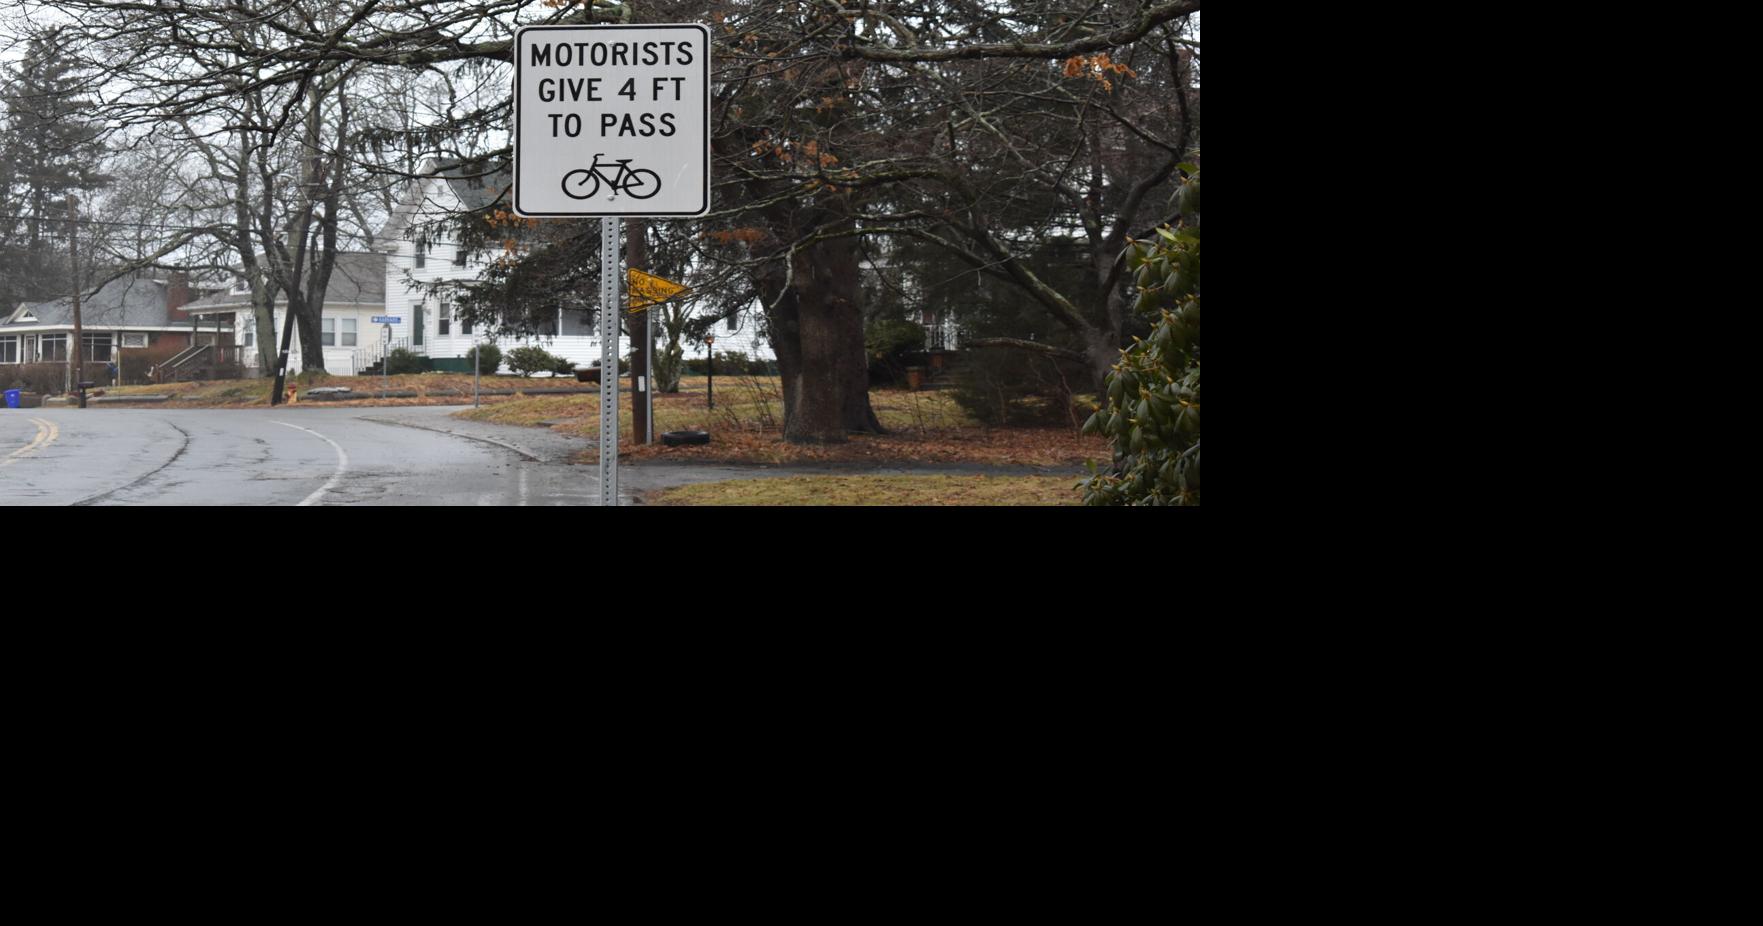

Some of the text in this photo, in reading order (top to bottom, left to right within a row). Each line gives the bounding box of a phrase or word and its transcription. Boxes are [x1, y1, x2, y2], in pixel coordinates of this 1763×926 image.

[531, 42, 693, 67] MOTORISTS
[538, 77, 686, 102] GIVE 4 FT
[548, 112, 676, 138] TO PASS
